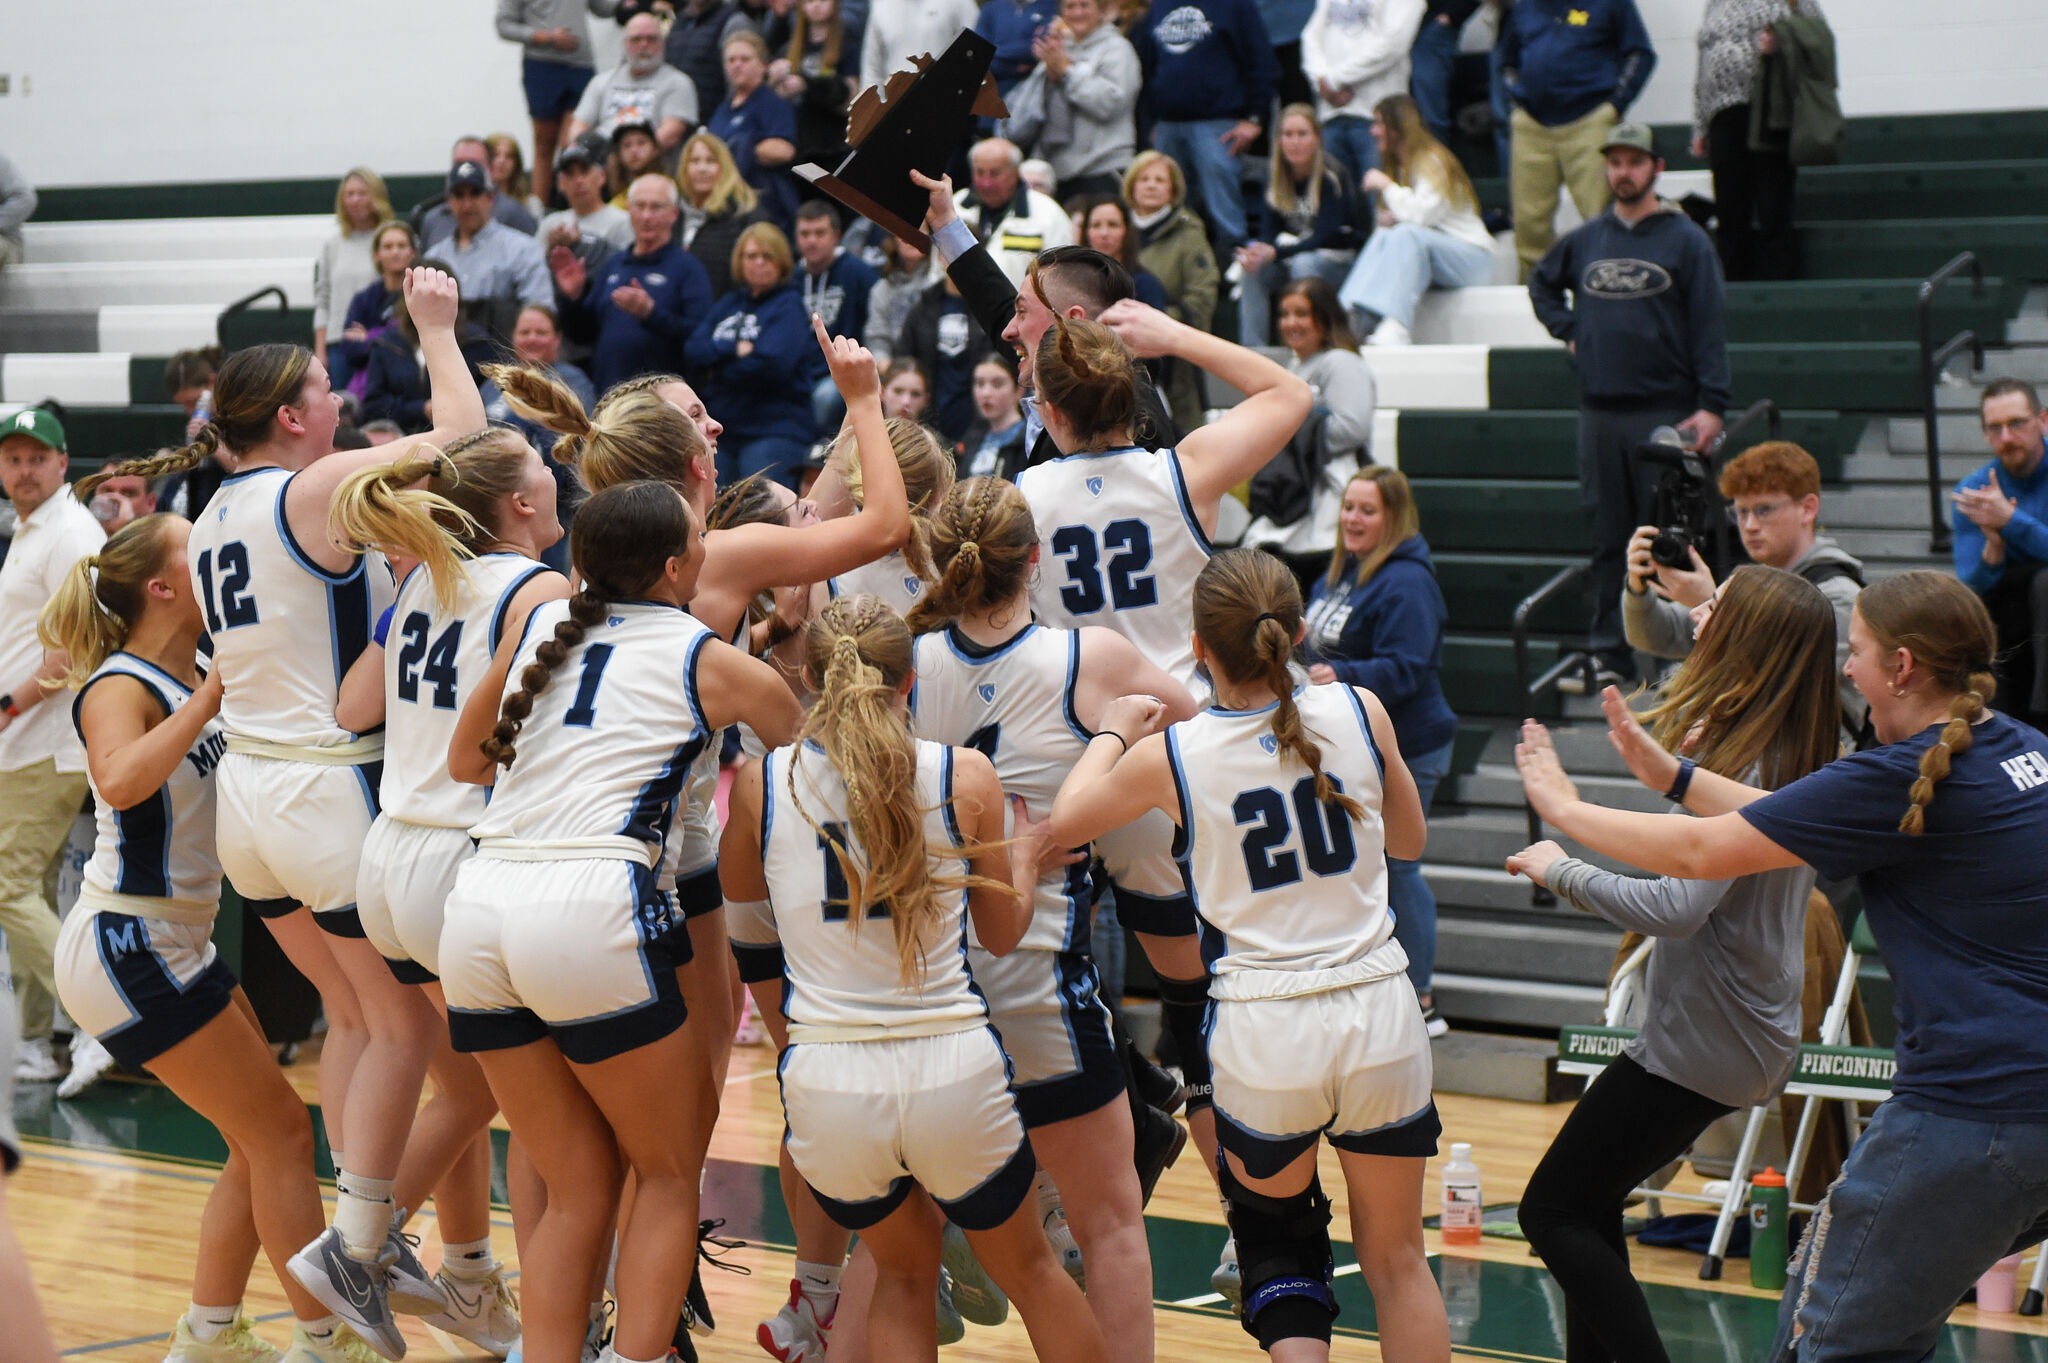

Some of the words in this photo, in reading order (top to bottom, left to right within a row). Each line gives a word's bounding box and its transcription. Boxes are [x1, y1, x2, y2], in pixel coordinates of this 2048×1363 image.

[197, 539, 261, 635] 12
[1050, 517, 1159, 616] 32
[398, 609, 465, 711] 24
[562, 641, 617, 730] 1
[1230, 770, 1358, 893] 20
[105, 921, 138, 962] M
[1259, 1281, 1313, 1298] DONJOY
